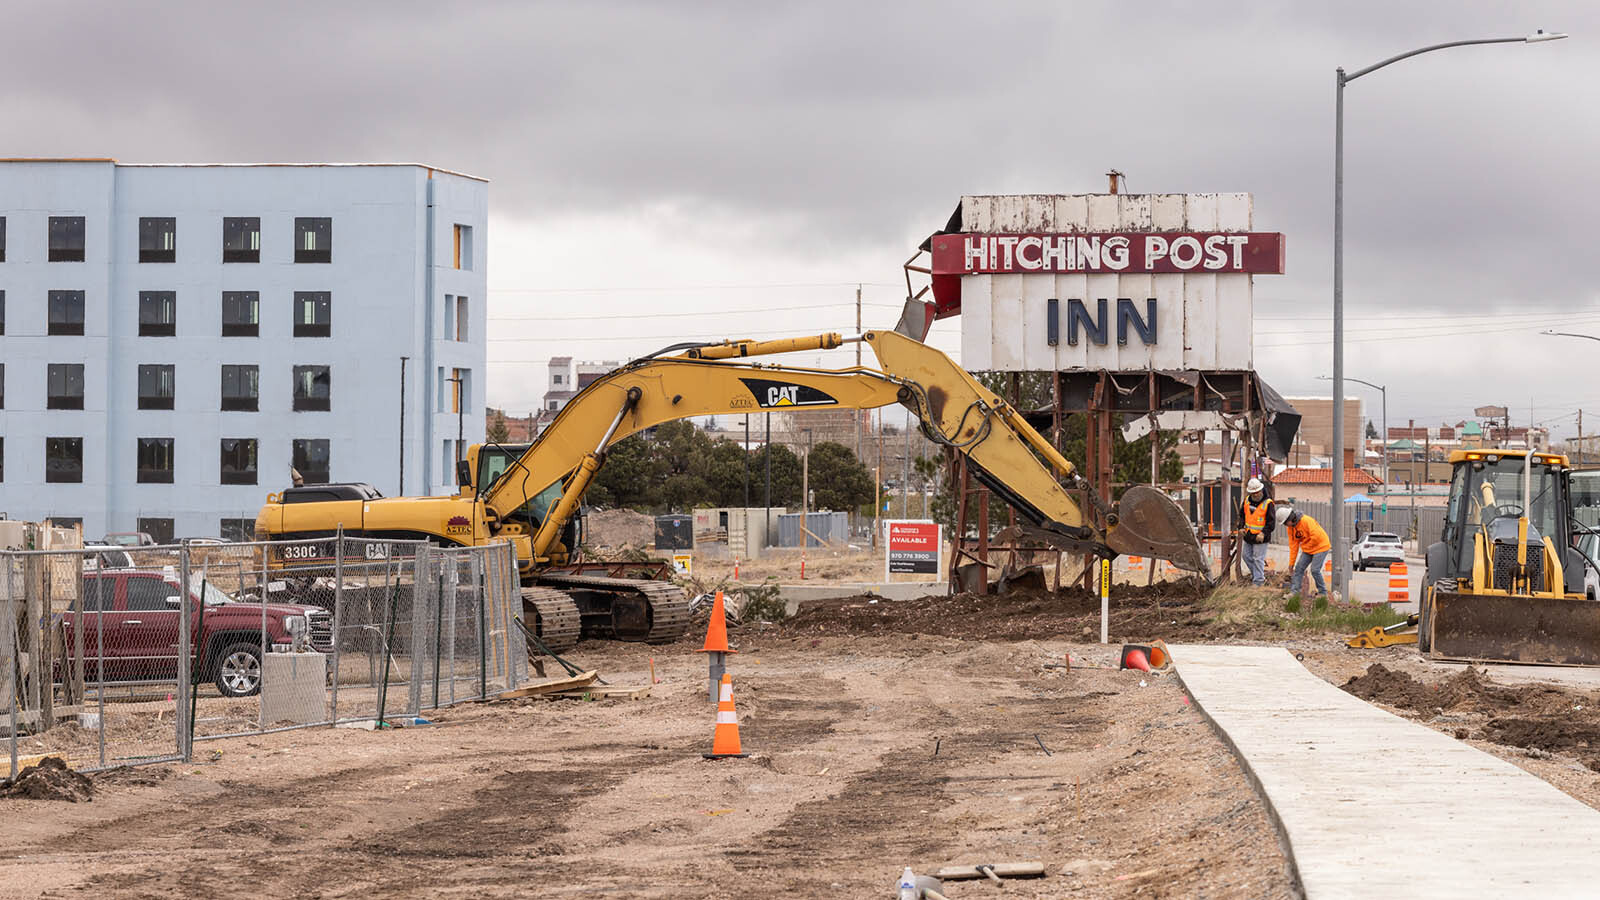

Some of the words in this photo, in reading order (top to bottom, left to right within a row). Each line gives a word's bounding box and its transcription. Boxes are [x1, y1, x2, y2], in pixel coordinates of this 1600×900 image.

[964, 235, 1129, 271] HITCHING
[1145, 235, 1249, 271] POST
[1047, 298, 1158, 346] INN
[768, 386, 799, 406] CAT
[285, 545, 317, 559] 330C
